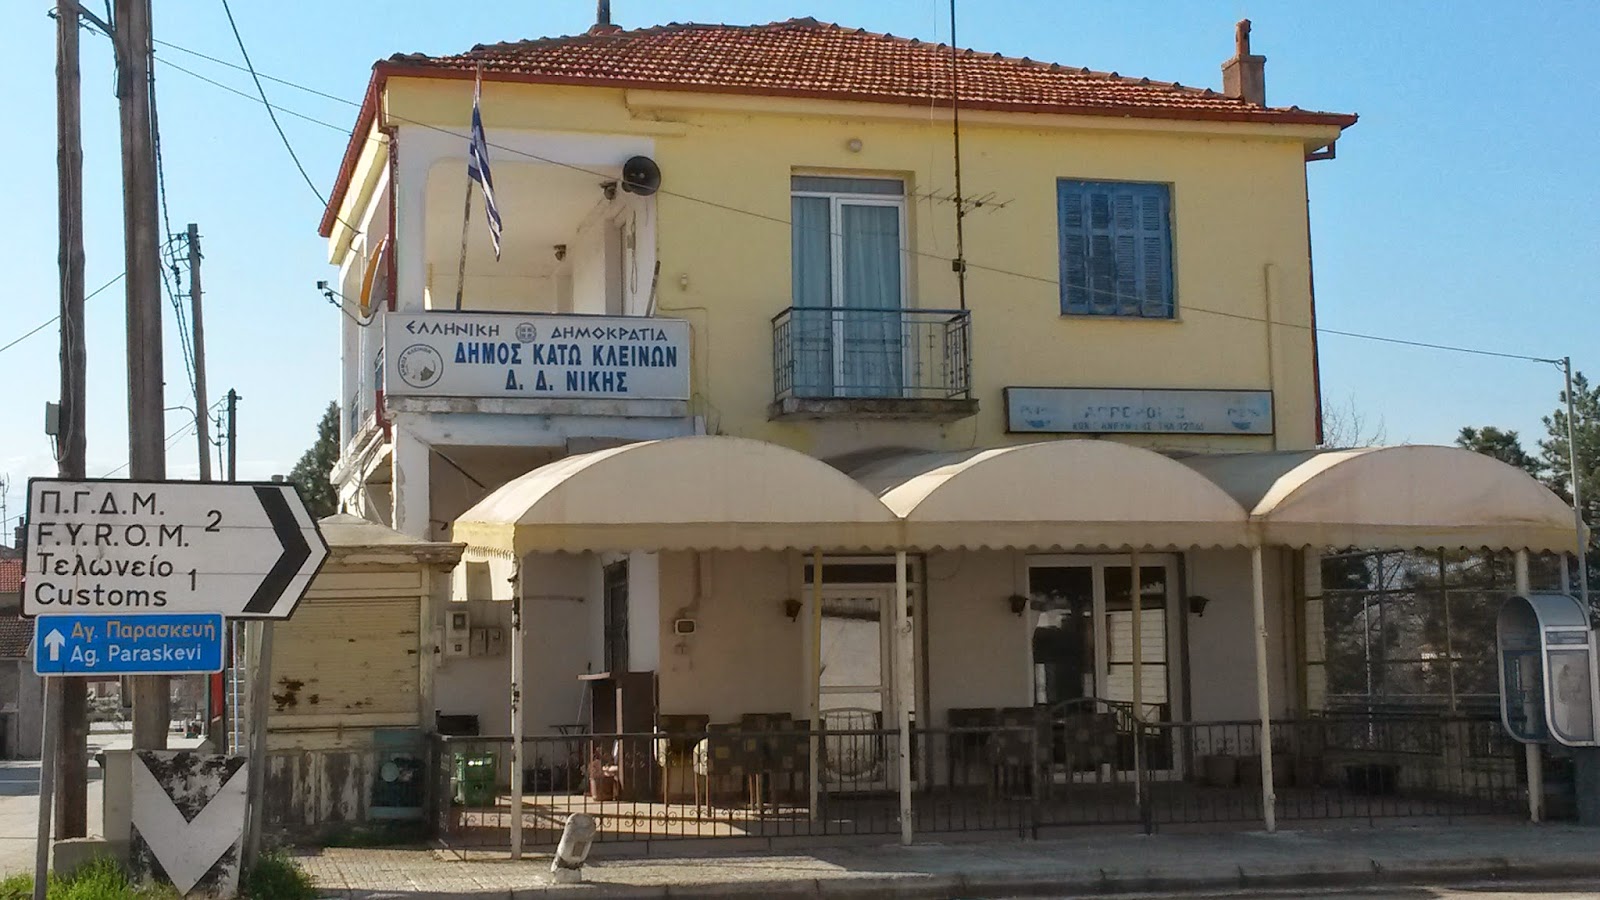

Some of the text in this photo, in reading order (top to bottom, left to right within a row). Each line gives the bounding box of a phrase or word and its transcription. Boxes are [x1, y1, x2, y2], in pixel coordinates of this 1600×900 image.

[406, 320, 500, 336] ΕΛΛΗΝΙΚΗ
[551, 326, 668, 341] ΔΗΜΟΚΡΑΤΙΑ
[455, 342, 677, 367] ΔΗΜΟΣ ΚΑΤΩ ΚΛΕΙΝΩΝ
[505, 369, 628, 392] Δ. Δ. ΝΙΚΗΣ
[40, 490, 165, 515] Π.Γ.Δ.Μ.
[205, 510, 222, 532] 2
[36, 522, 189, 547] F.Y.R.O.M.
[37, 552, 173, 577] Τελωνείο
[188, 569, 197, 591] 1
[35, 582, 167, 606] Customs
[71, 620, 216, 642] Αγ. Παρασκευή
[69, 643, 202, 666] Ag. Paraskevi
